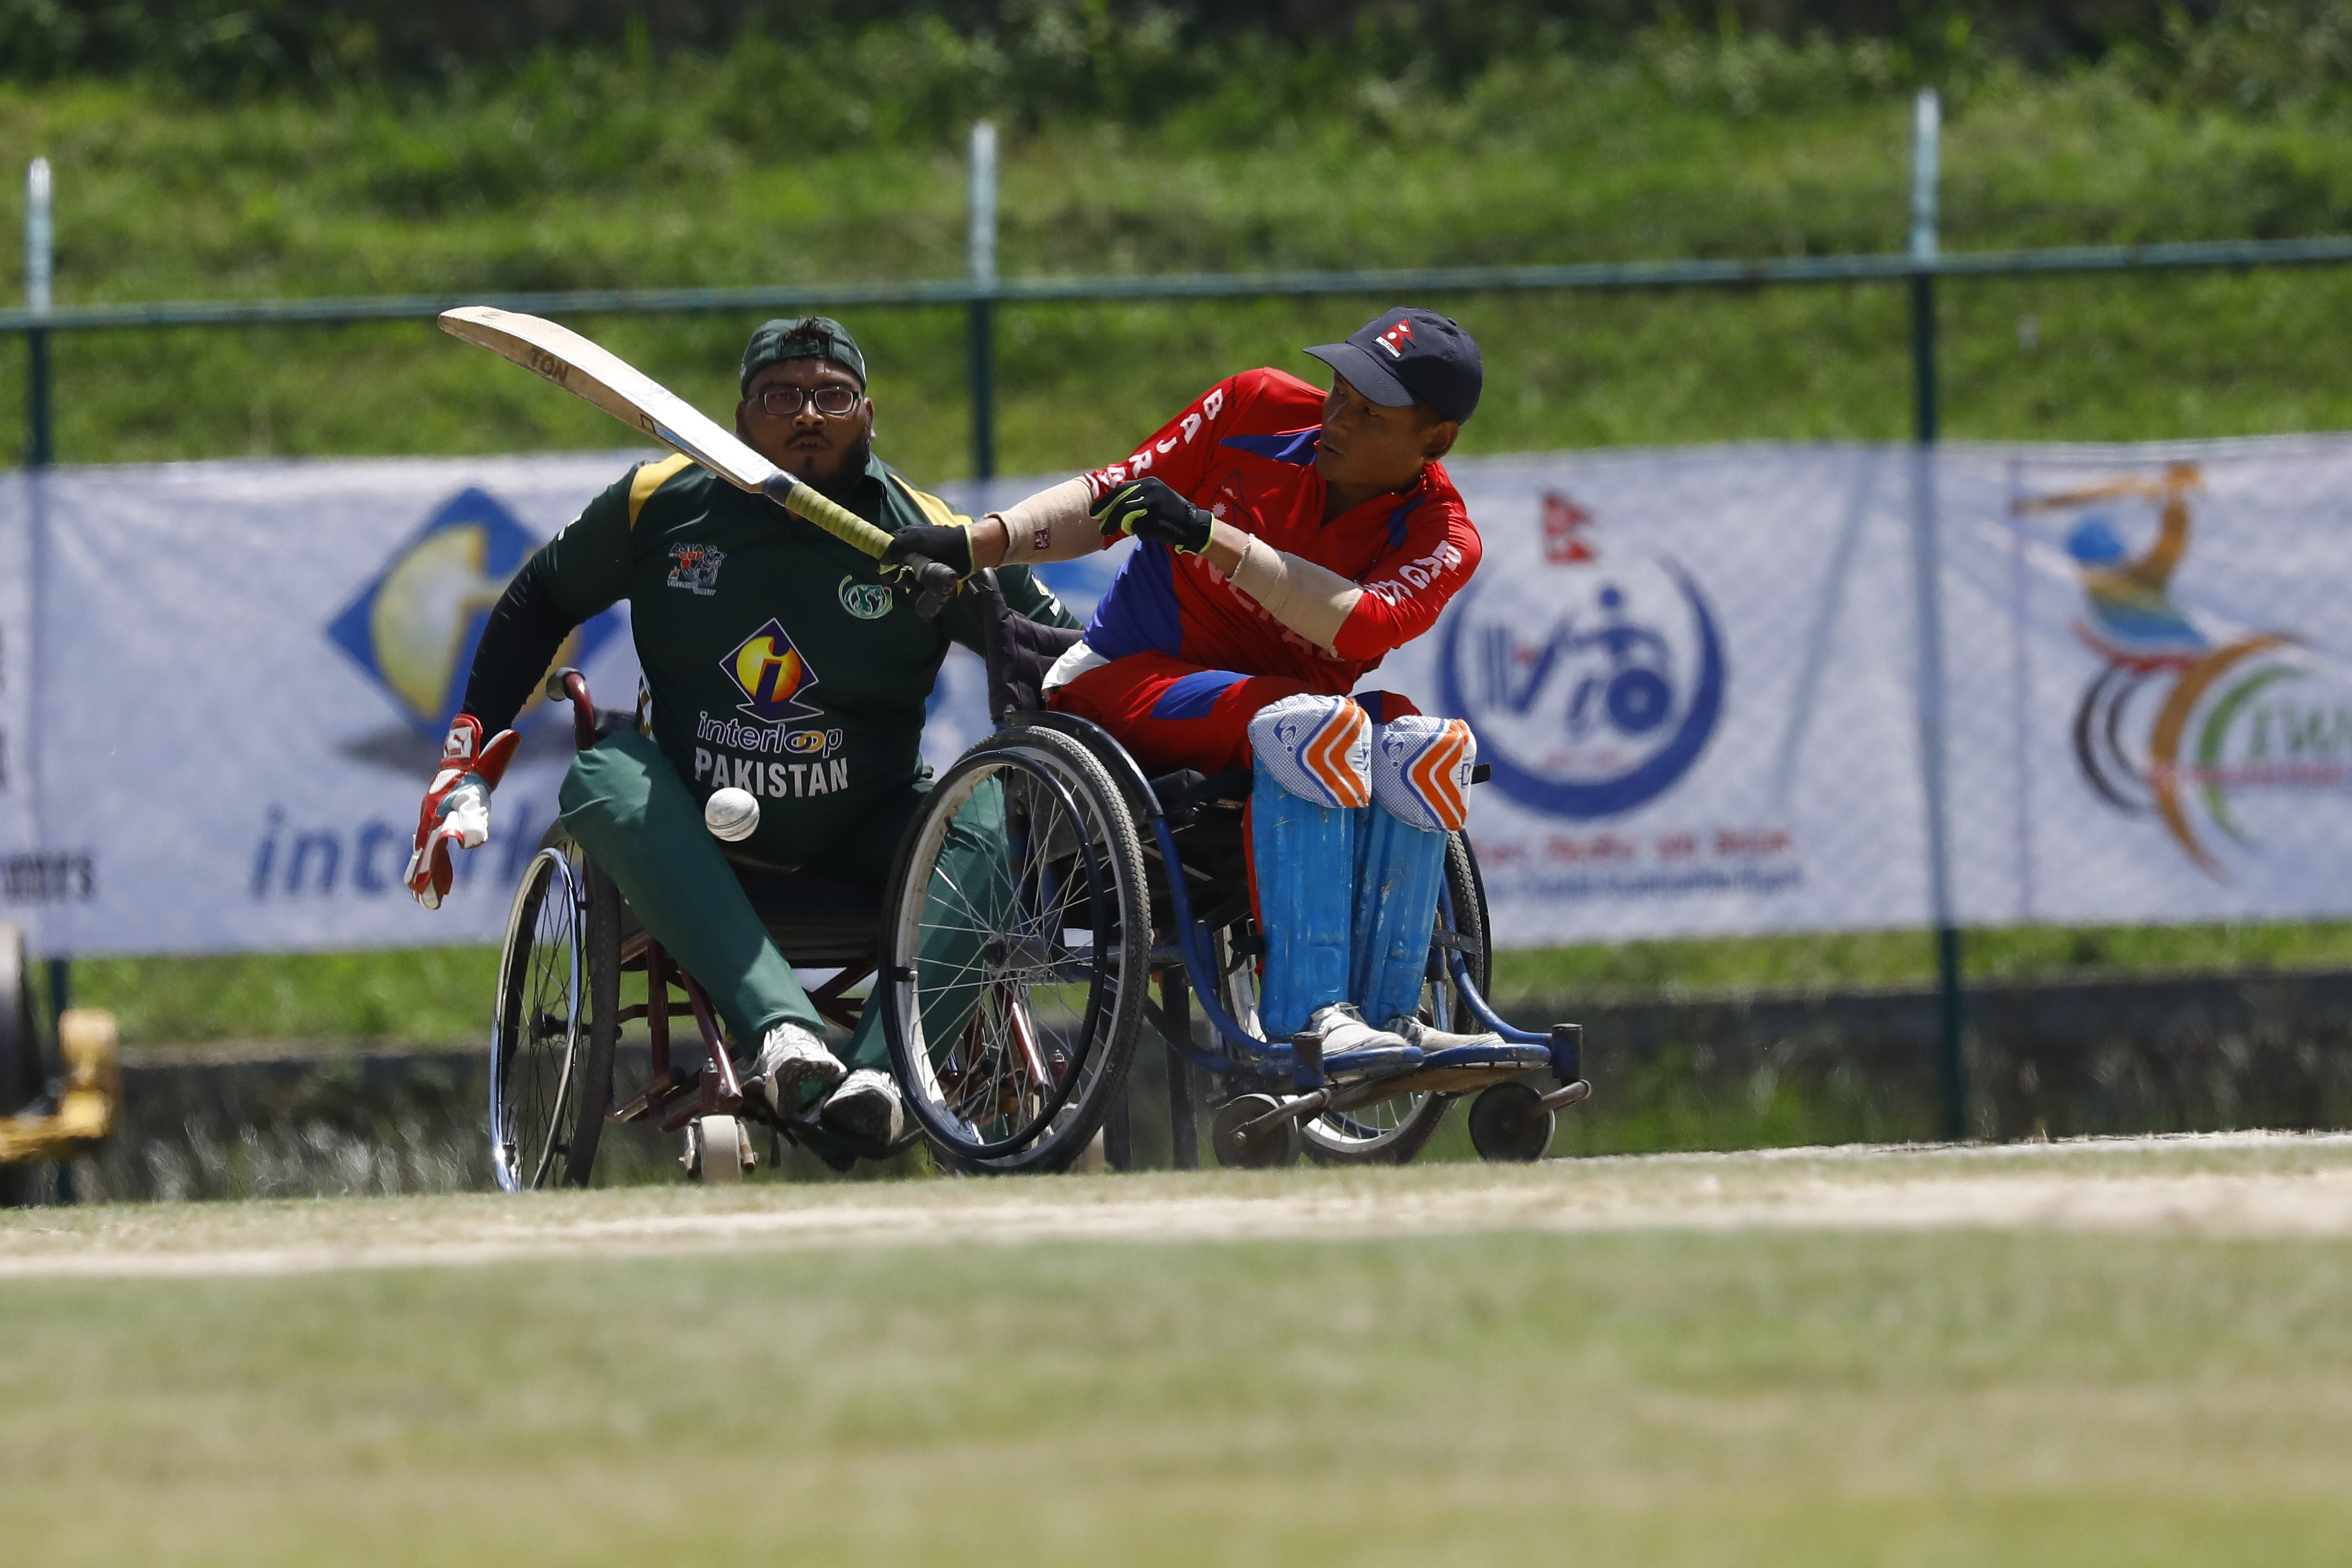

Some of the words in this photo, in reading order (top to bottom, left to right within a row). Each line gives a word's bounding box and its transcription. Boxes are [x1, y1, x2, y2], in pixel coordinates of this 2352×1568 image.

[530, 345, 570, 385] TON
[697, 710, 843, 758] interloop
[694, 747, 849, 798] PAKISTAN
